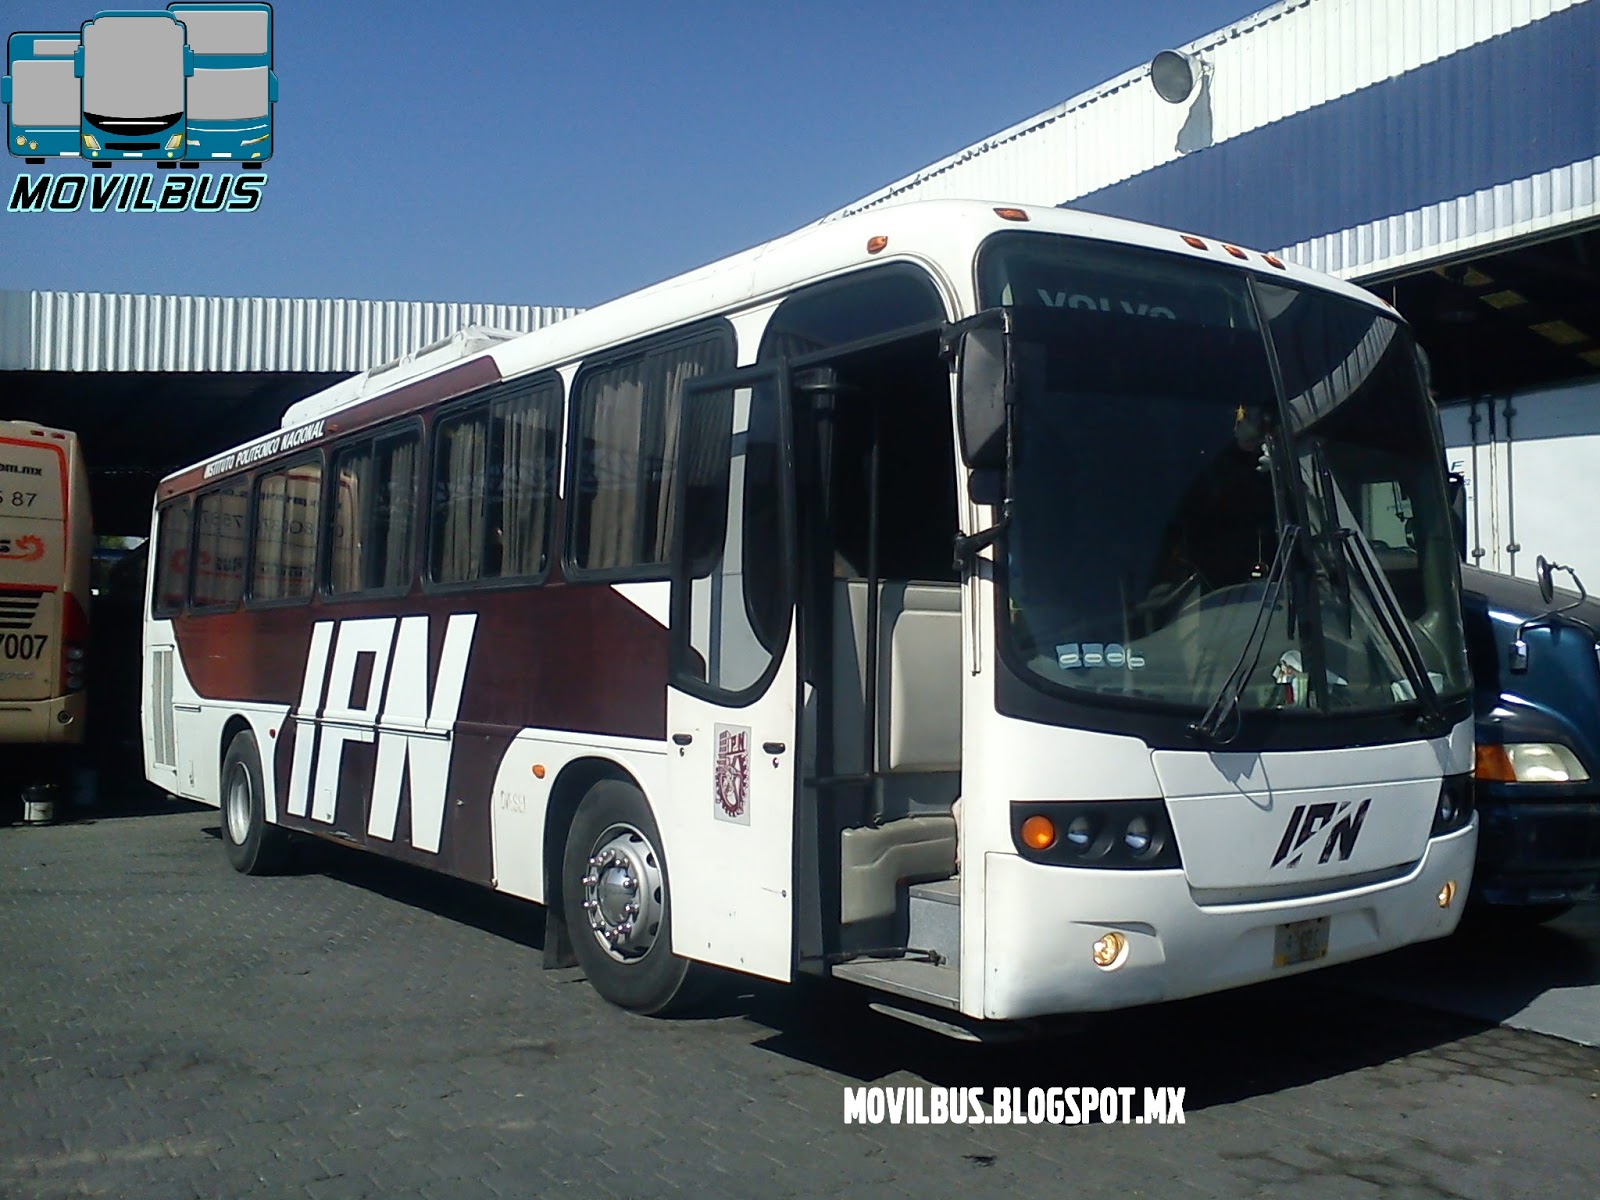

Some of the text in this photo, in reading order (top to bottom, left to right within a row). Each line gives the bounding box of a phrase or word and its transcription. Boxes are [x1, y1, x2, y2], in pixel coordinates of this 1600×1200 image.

[235, 437, 280, 468] POLITECNICO
[280, 420, 325, 451] NACIONAL
[12, 491, 37, 507] 87
[286, 613, 478, 854] IPN
[1269, 798, 1372, 870] IPN
